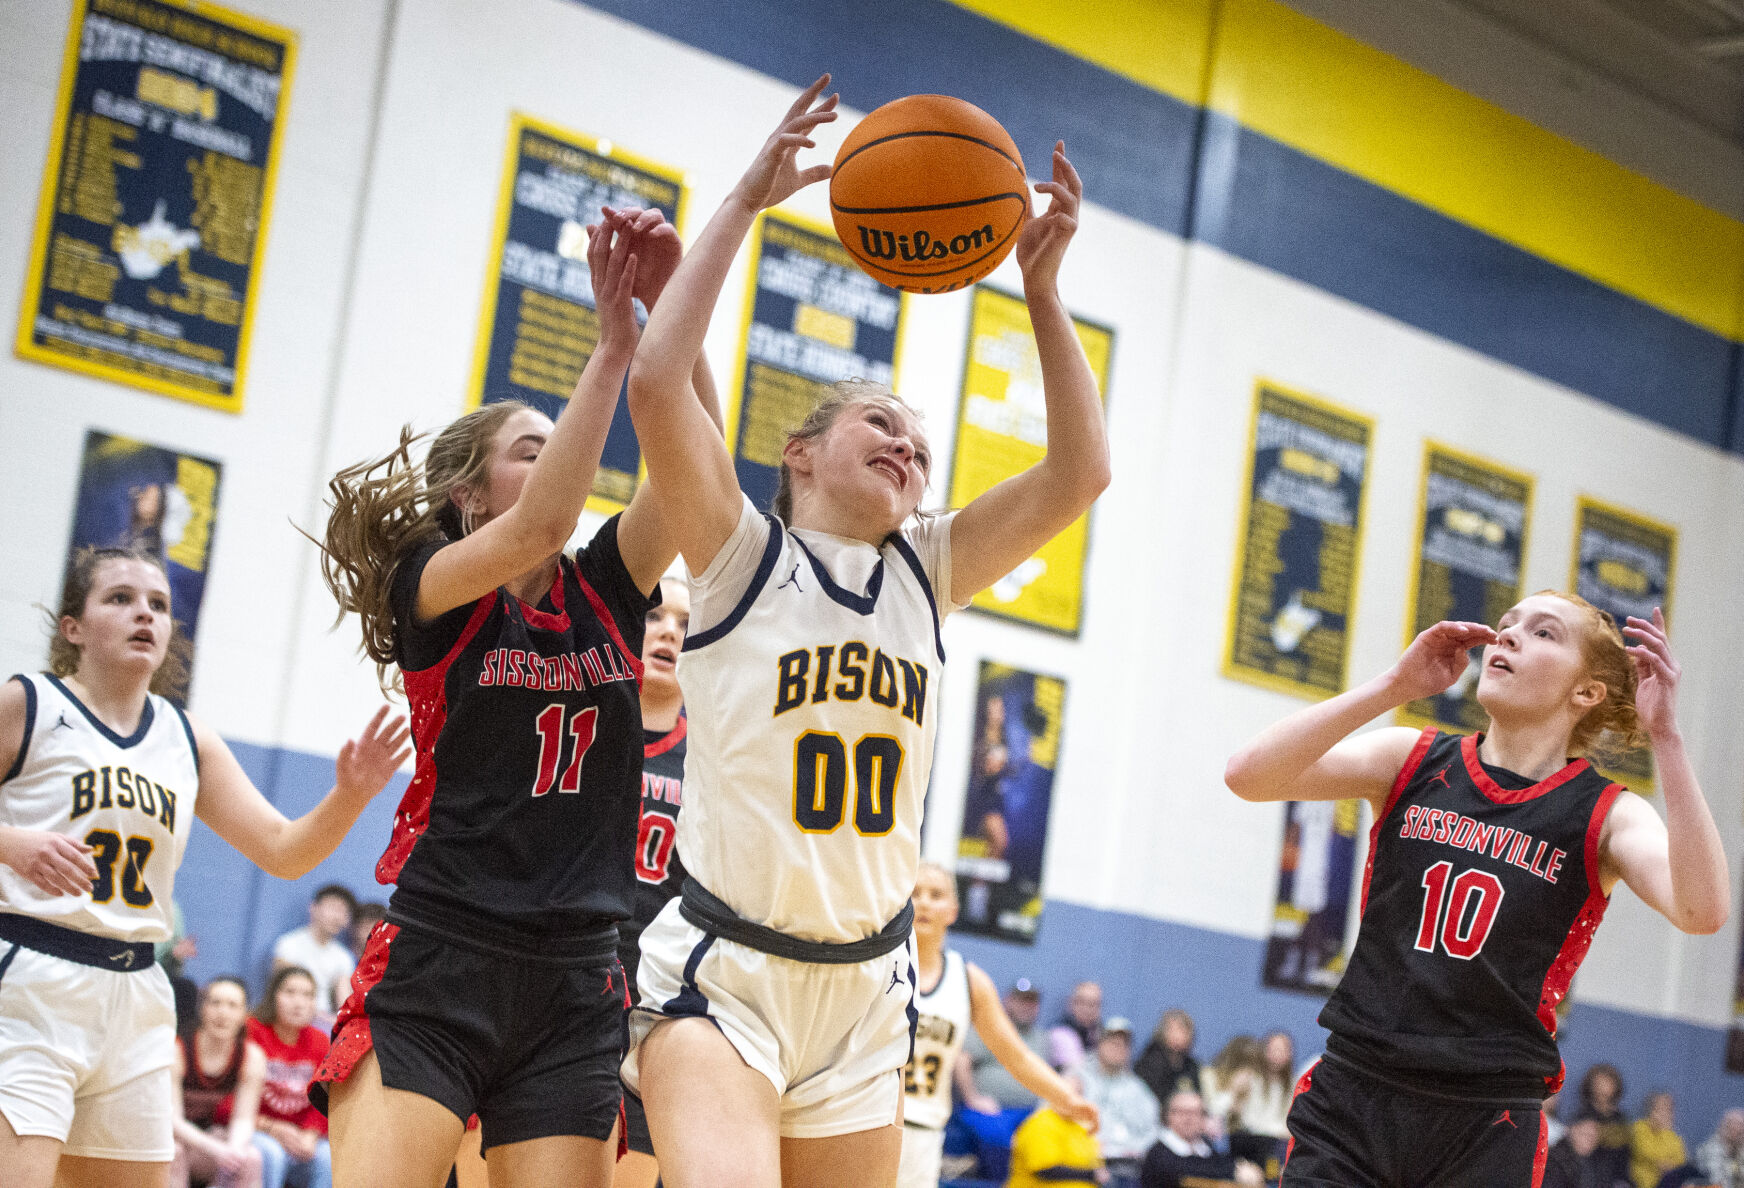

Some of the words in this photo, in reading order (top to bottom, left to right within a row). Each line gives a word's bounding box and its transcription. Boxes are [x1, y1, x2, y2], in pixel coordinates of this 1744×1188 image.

[857, 224, 996, 262] Wilson
[773, 640, 929, 729] BISON
[532, 703, 599, 797] 11
[792, 728, 906, 838] 00
[70, 765, 177, 835] BISON
[84, 827, 155, 909] 30
[1400, 804, 1567, 885] SISSONVILLE
[1413, 860, 1505, 961] 10
